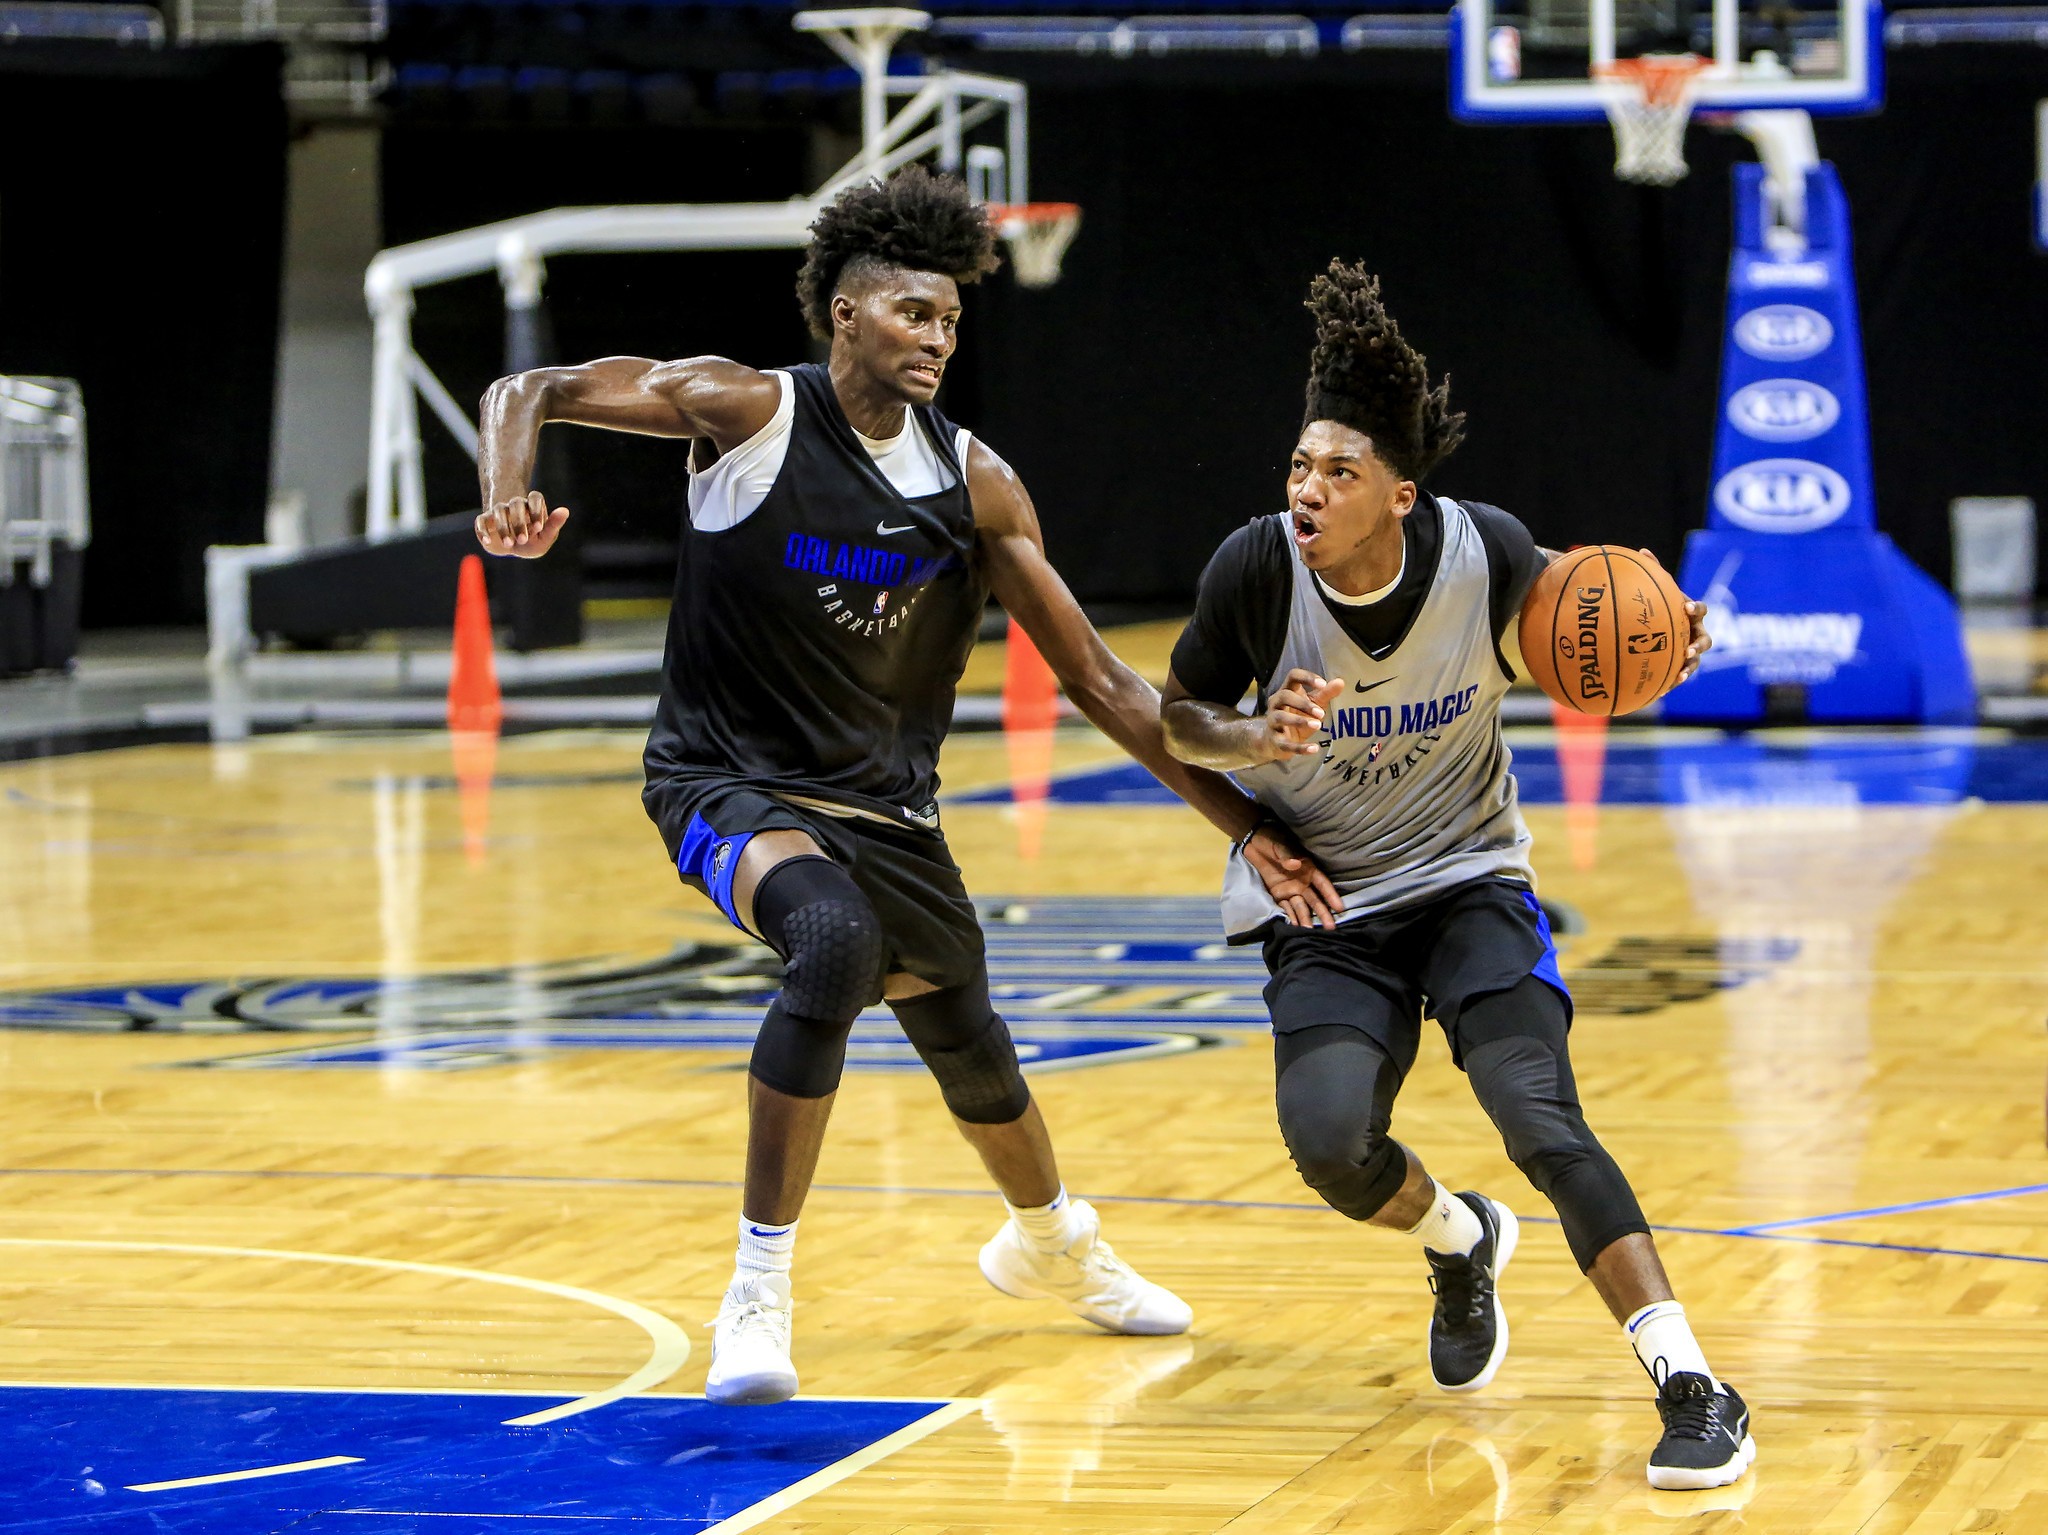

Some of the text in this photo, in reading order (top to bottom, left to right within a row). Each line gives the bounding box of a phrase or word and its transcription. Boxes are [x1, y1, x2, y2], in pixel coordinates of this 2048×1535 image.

[783, 531, 907, 586] ORLANDO
[817, 583, 927, 637] BASKETBA
[1577, 586, 1610, 699] SPALDING
[1320, 683, 1479, 741] LANDO MAGIC
